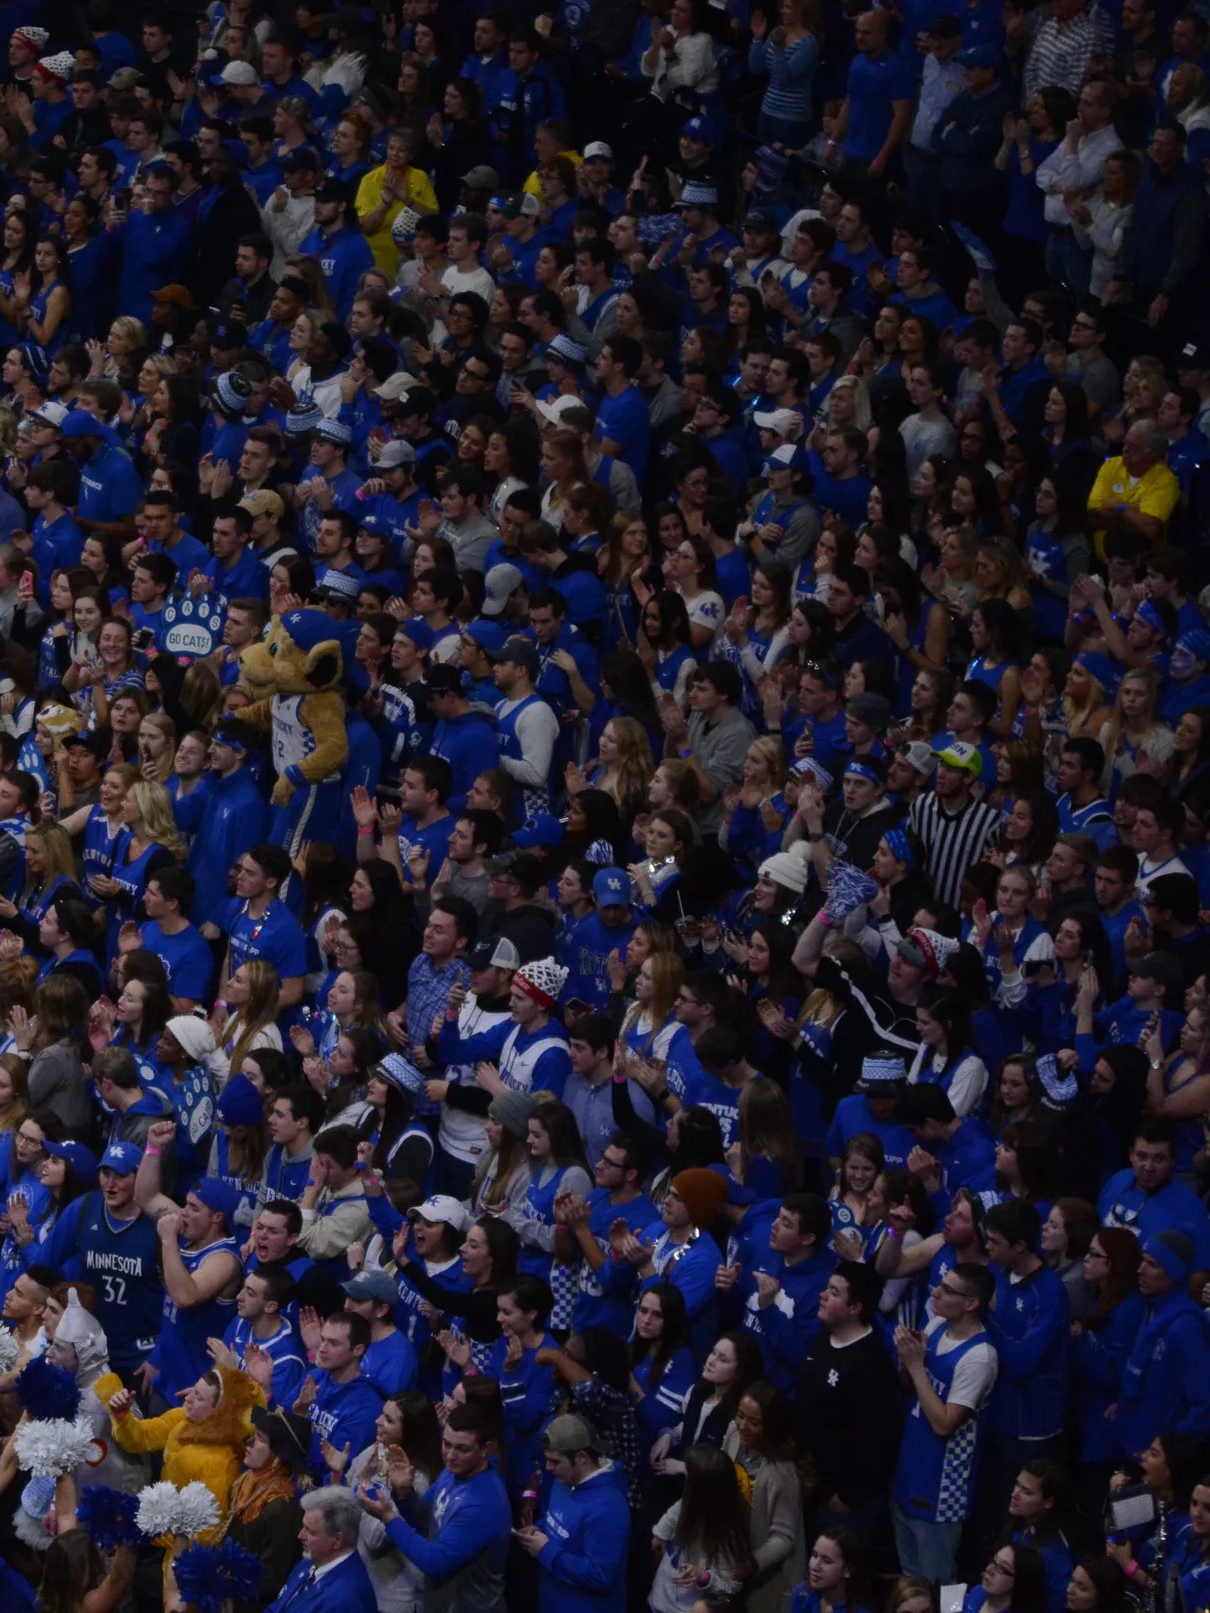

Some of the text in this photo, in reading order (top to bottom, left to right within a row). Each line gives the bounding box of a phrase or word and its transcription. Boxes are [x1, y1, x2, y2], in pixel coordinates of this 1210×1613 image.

[169, 633, 210, 648] GO CATS!
[86, 1250, 143, 1277] MINNESOTA
[102, 1276, 127, 1306] 32
